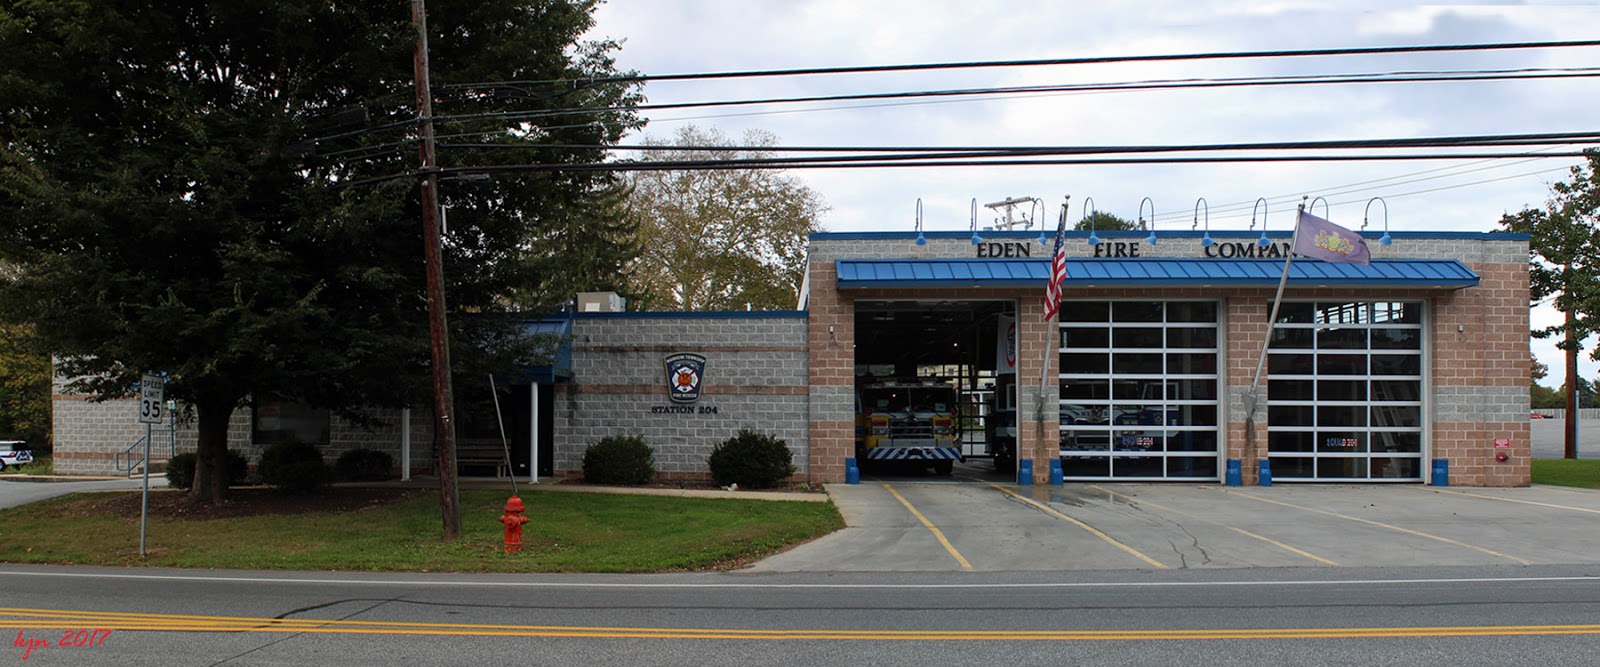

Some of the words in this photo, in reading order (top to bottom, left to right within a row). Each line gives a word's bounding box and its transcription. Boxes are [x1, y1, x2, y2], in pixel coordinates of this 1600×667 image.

[976, 242, 1031, 258] EDEN
[1093, 242, 1140, 258] FIRE
[1205, 242, 1309, 259] COMPAN
[144, 380, 161, 389] SPEED
[144, 390, 160, 399] LIMIT
[142, 399, 160, 418] 35
[651, 405, 695, 414] STATION
[698, 405, 718, 415] 204
